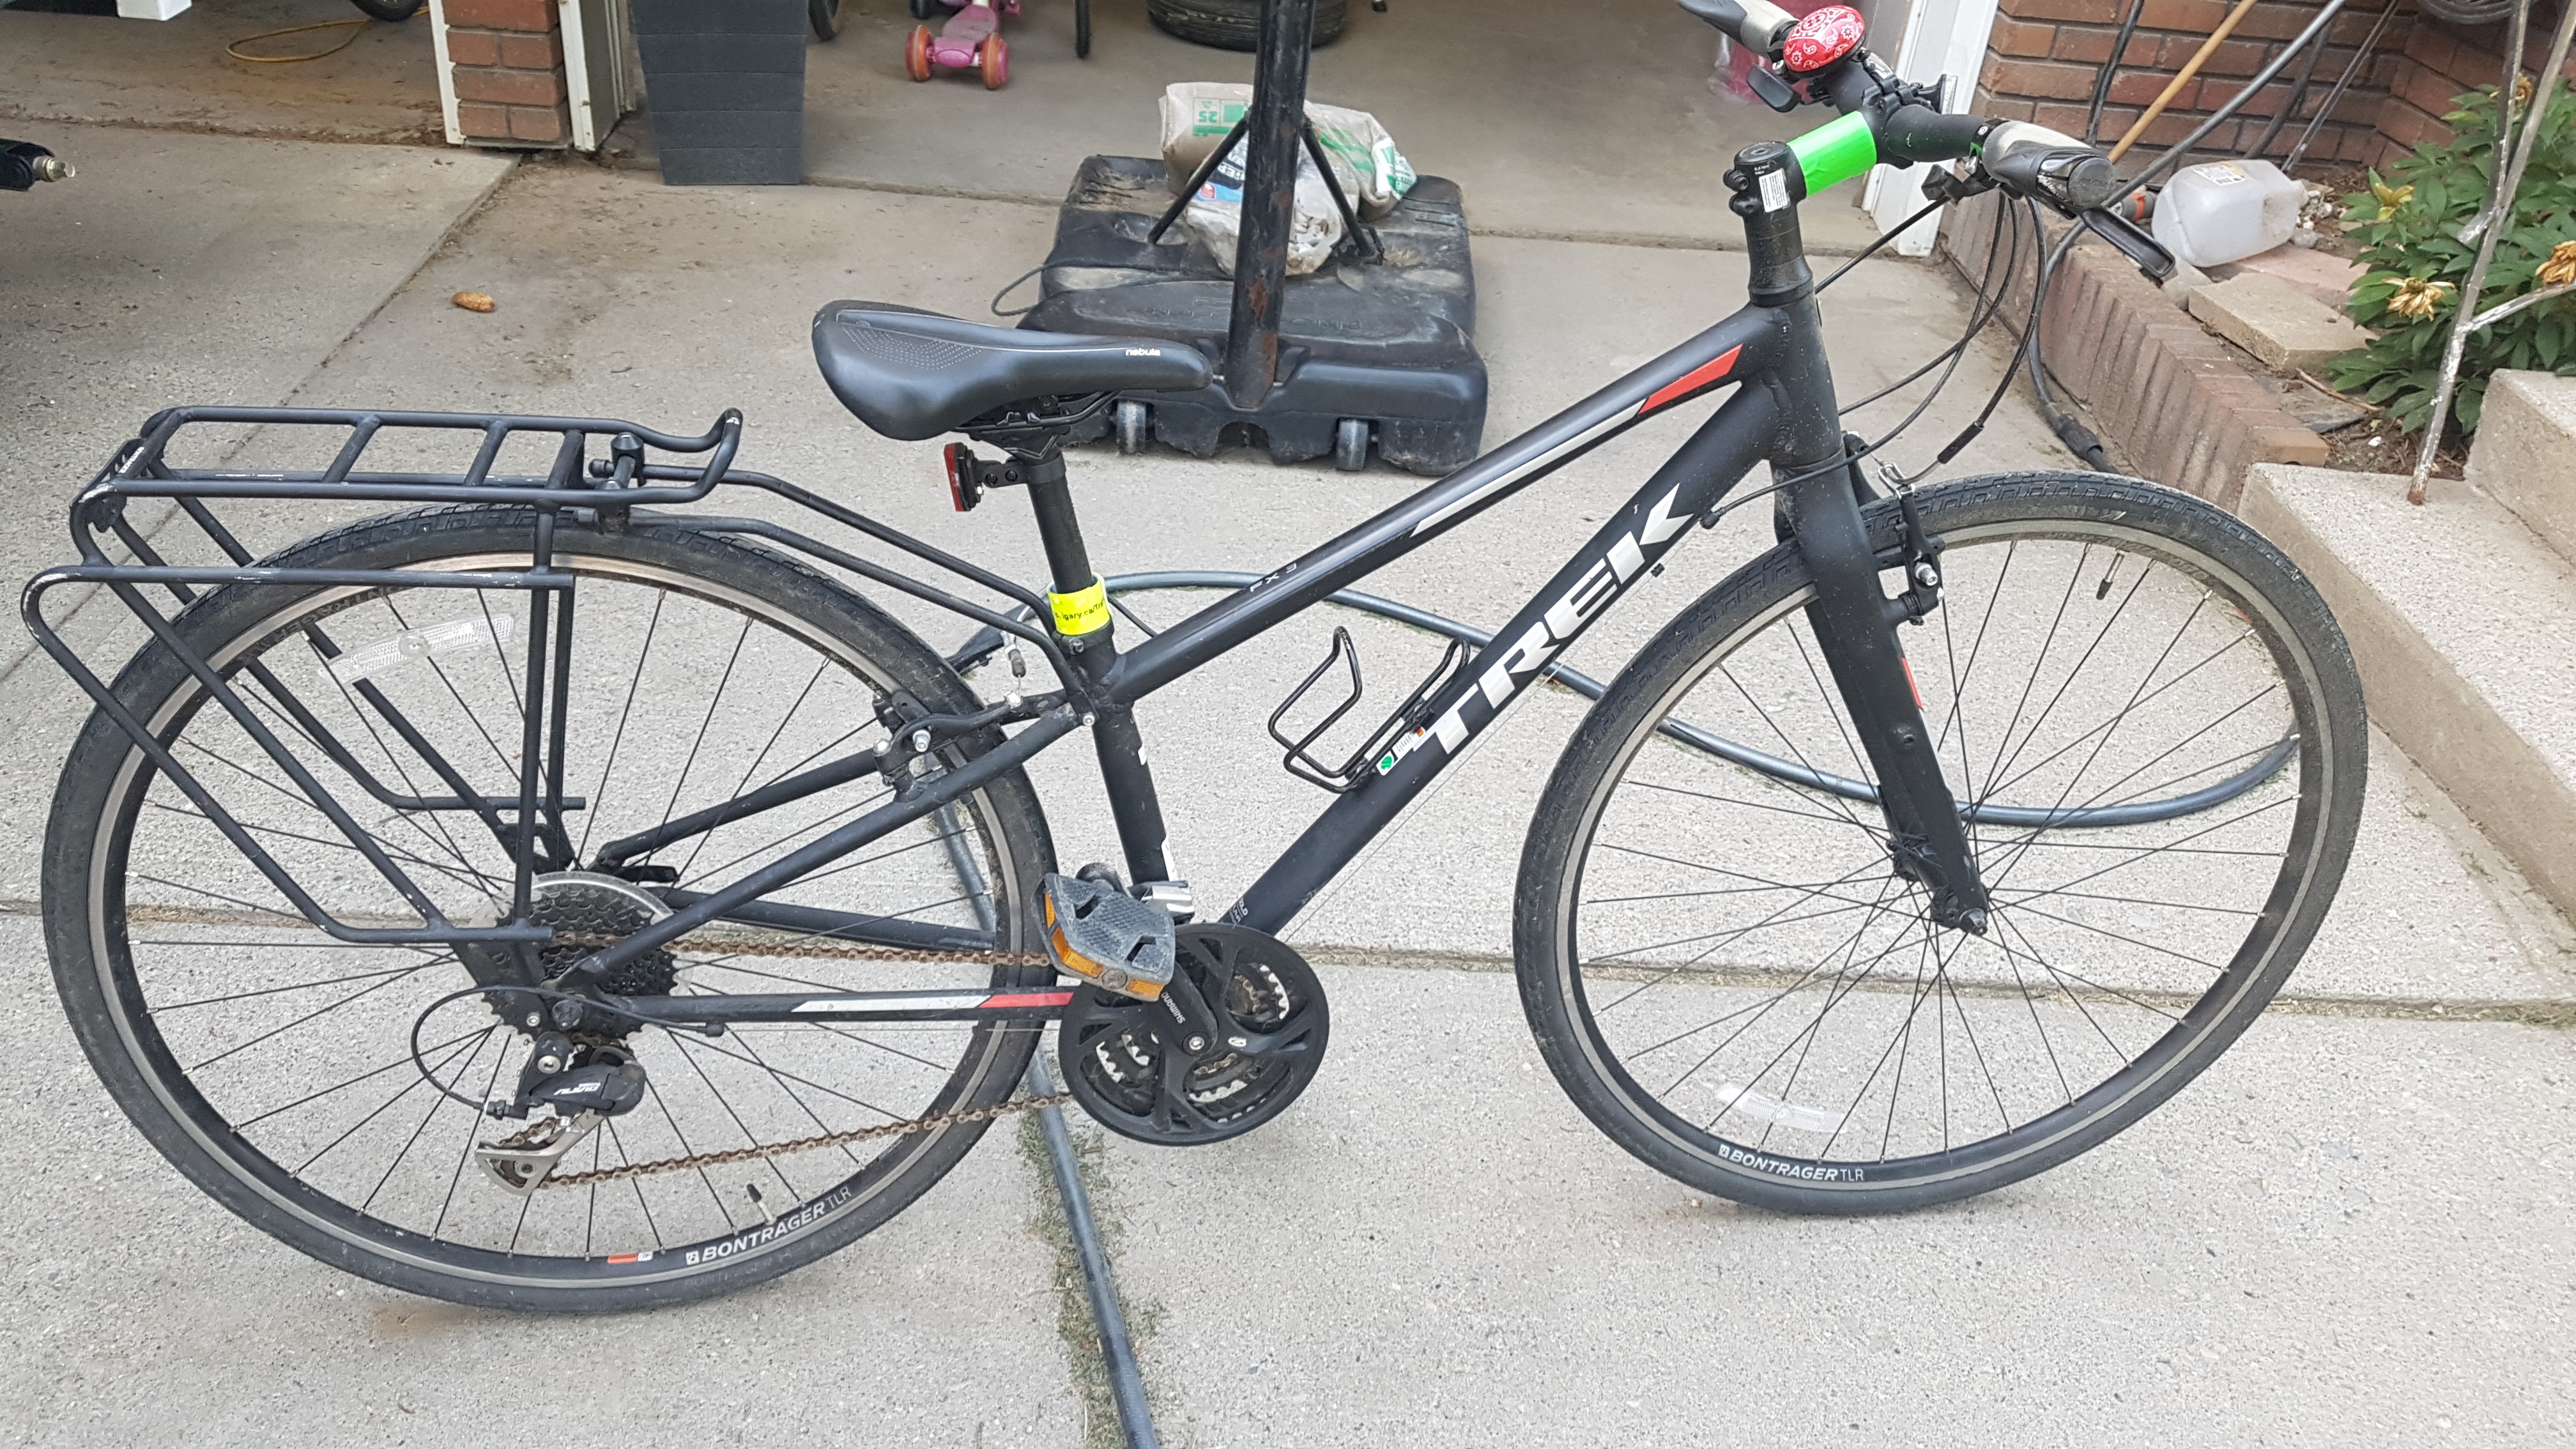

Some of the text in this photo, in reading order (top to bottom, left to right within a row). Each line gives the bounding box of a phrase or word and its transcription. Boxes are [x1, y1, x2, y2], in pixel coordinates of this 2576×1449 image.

[1199, 110, 1218, 123] 25
[1125, 348, 1161, 356] nebula
[1413, 483, 1695, 755] TREK
[1161, 992, 1186, 1023] SHIMANO
[1729, 1150, 1838, 1181] BONTRAGER
[1839, 1169, 1864, 1181] TLR
[702, 1201, 825, 1262] BONTRAGER
[826, 1186, 853, 1208] TLR
